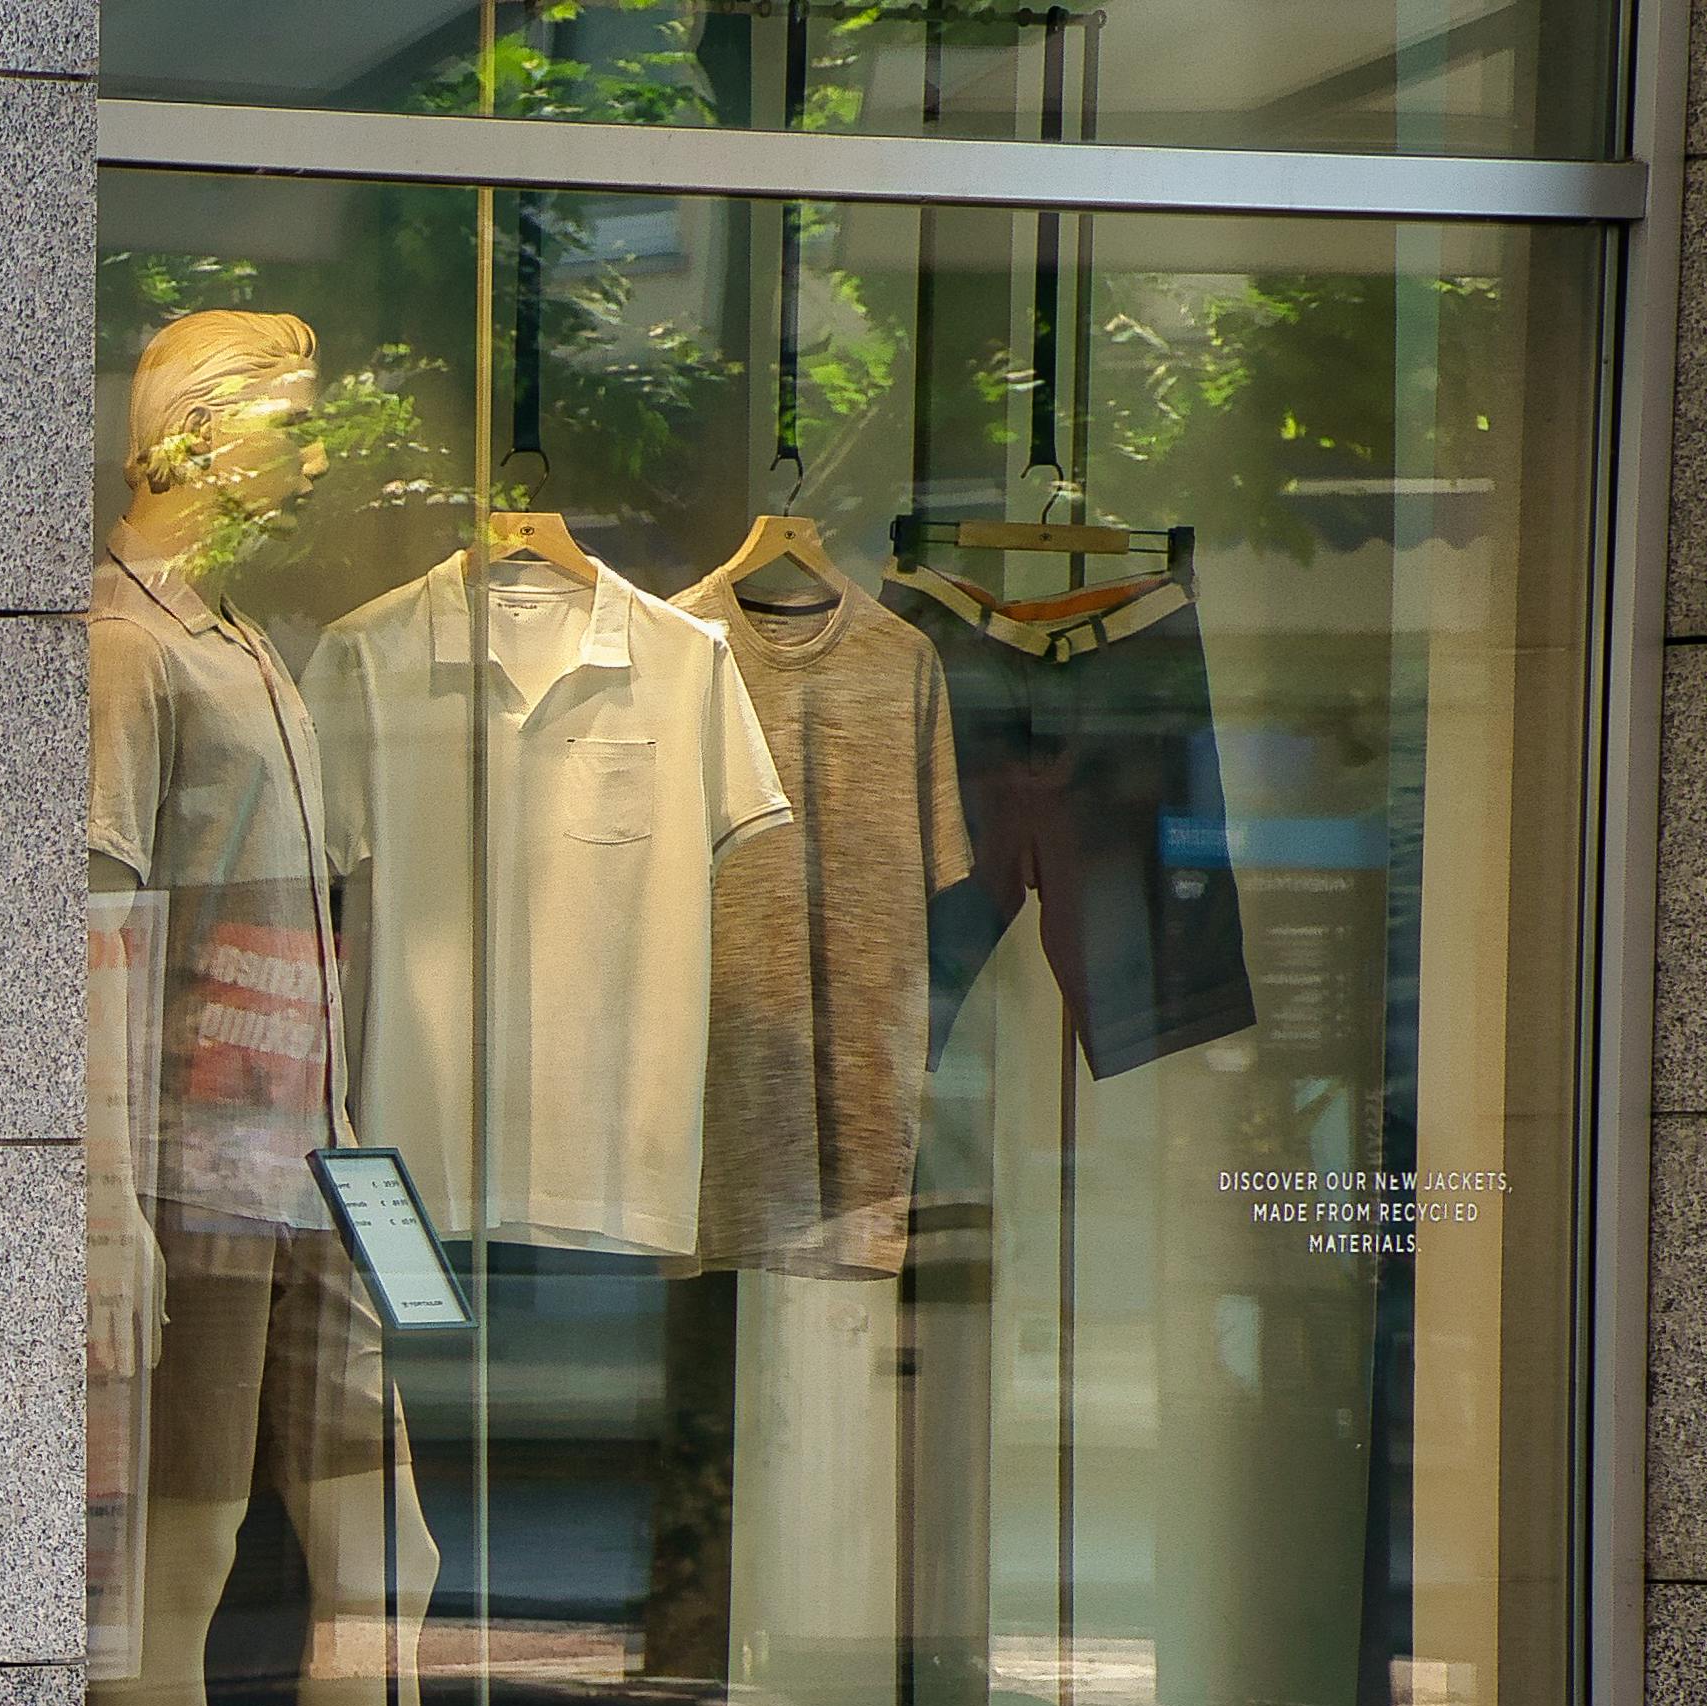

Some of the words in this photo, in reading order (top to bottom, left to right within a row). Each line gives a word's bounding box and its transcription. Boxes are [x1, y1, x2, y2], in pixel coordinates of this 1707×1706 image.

[1218, 1171, 1318, 1192] DISCOVER
[1326, 1171, 1367, 1191] OUR
[1374, 1171, 1418, 1191] NEW
[1252, 1202, 1308, 1223] MADE
[1315, 1202, 1371, 1222] FROM
[1379, 1202, 1479, 1222] RECYCLED
[1309, 1234, 1423, 1254] MATERIALS.
